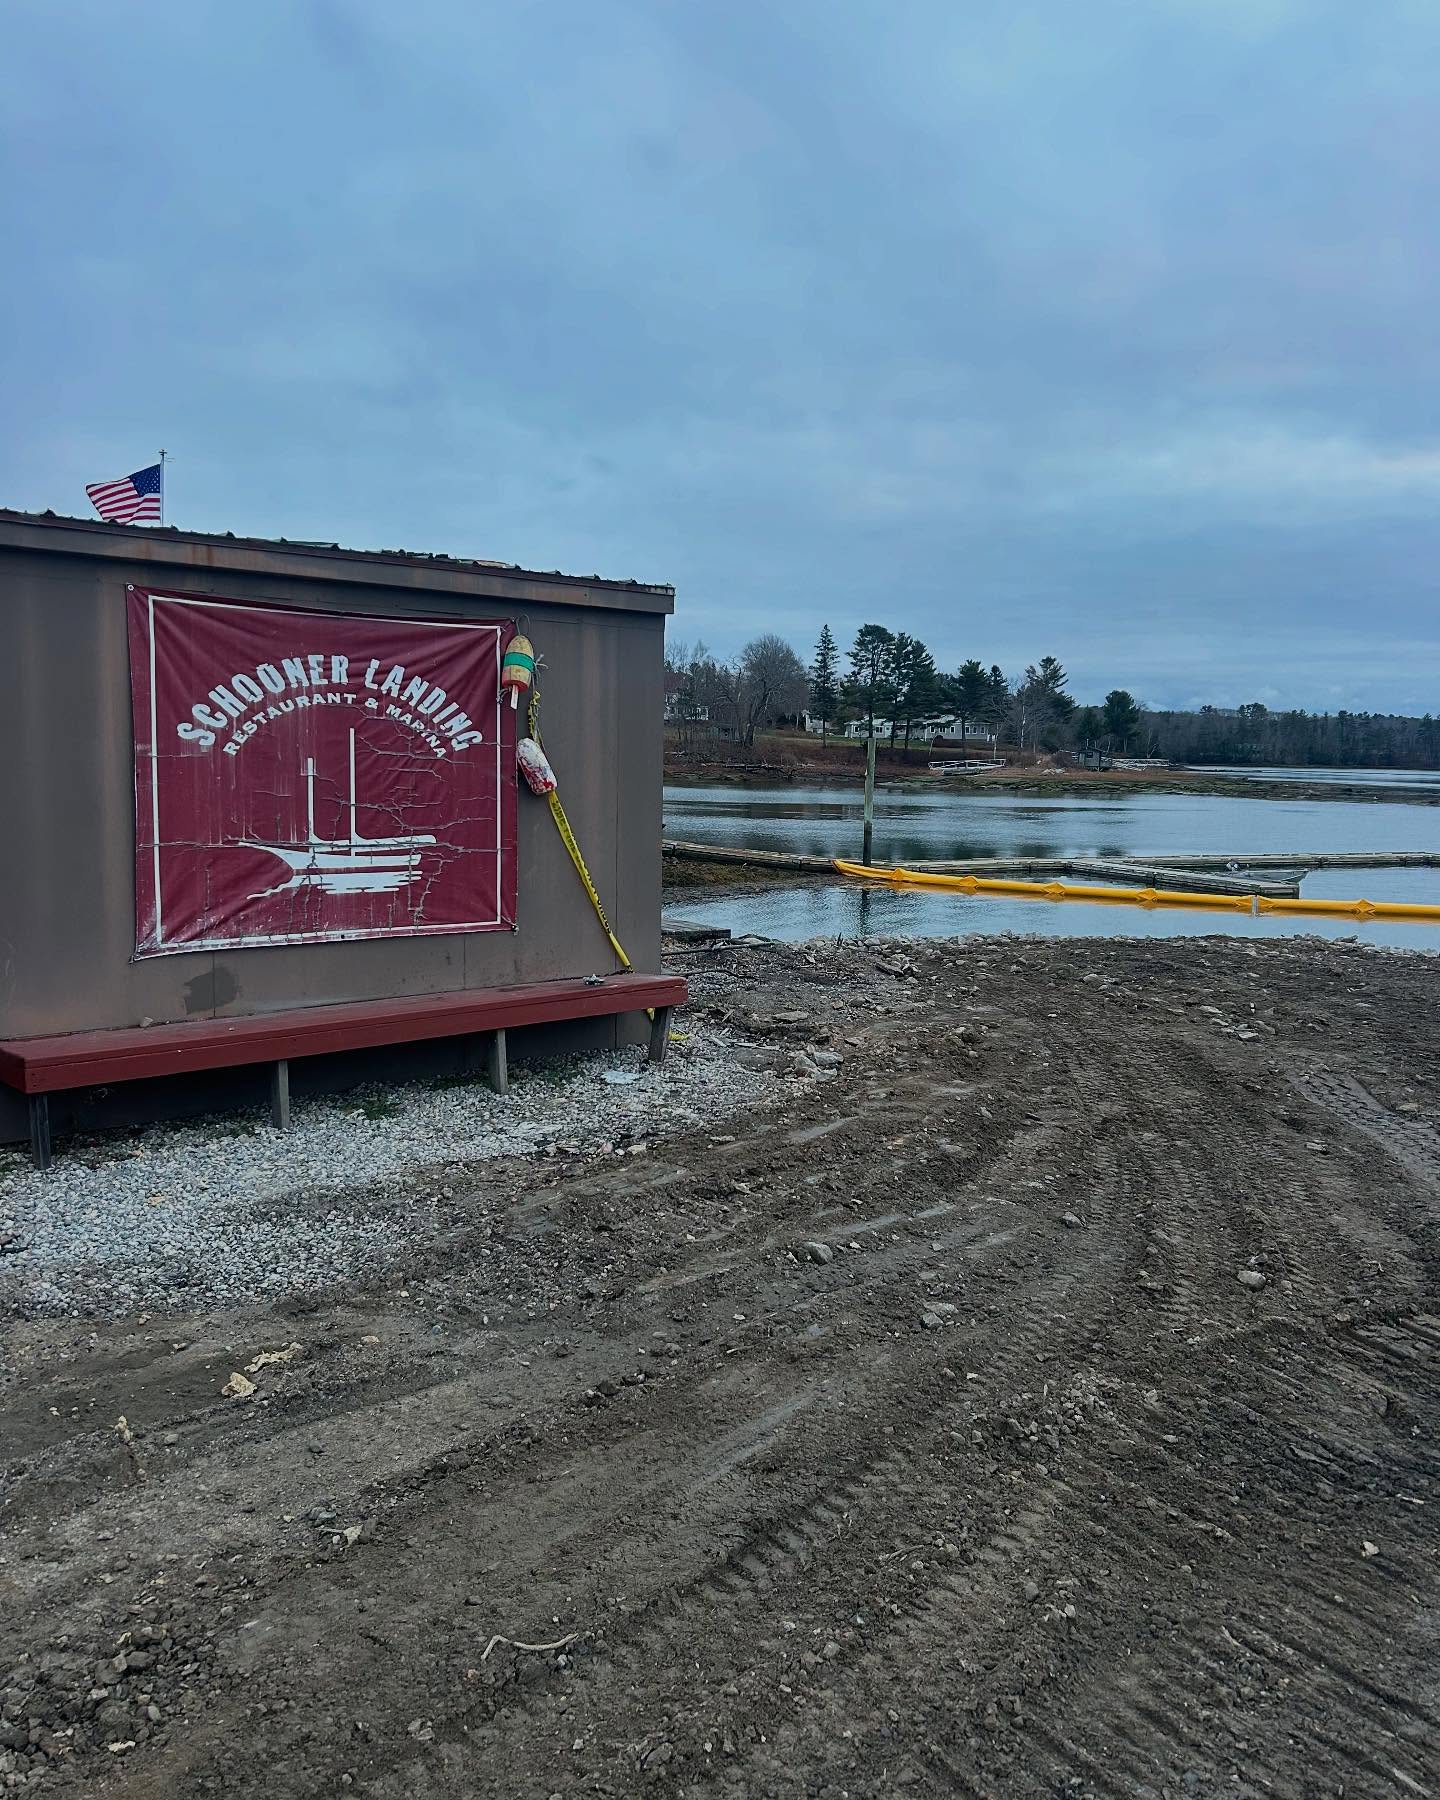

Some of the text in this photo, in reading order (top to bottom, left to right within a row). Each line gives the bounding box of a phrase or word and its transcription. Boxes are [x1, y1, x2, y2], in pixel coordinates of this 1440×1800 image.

[177, 654, 483, 751] SCHOONER LANDING
[223, 692, 447, 758] RESTAURANT & MARINA
